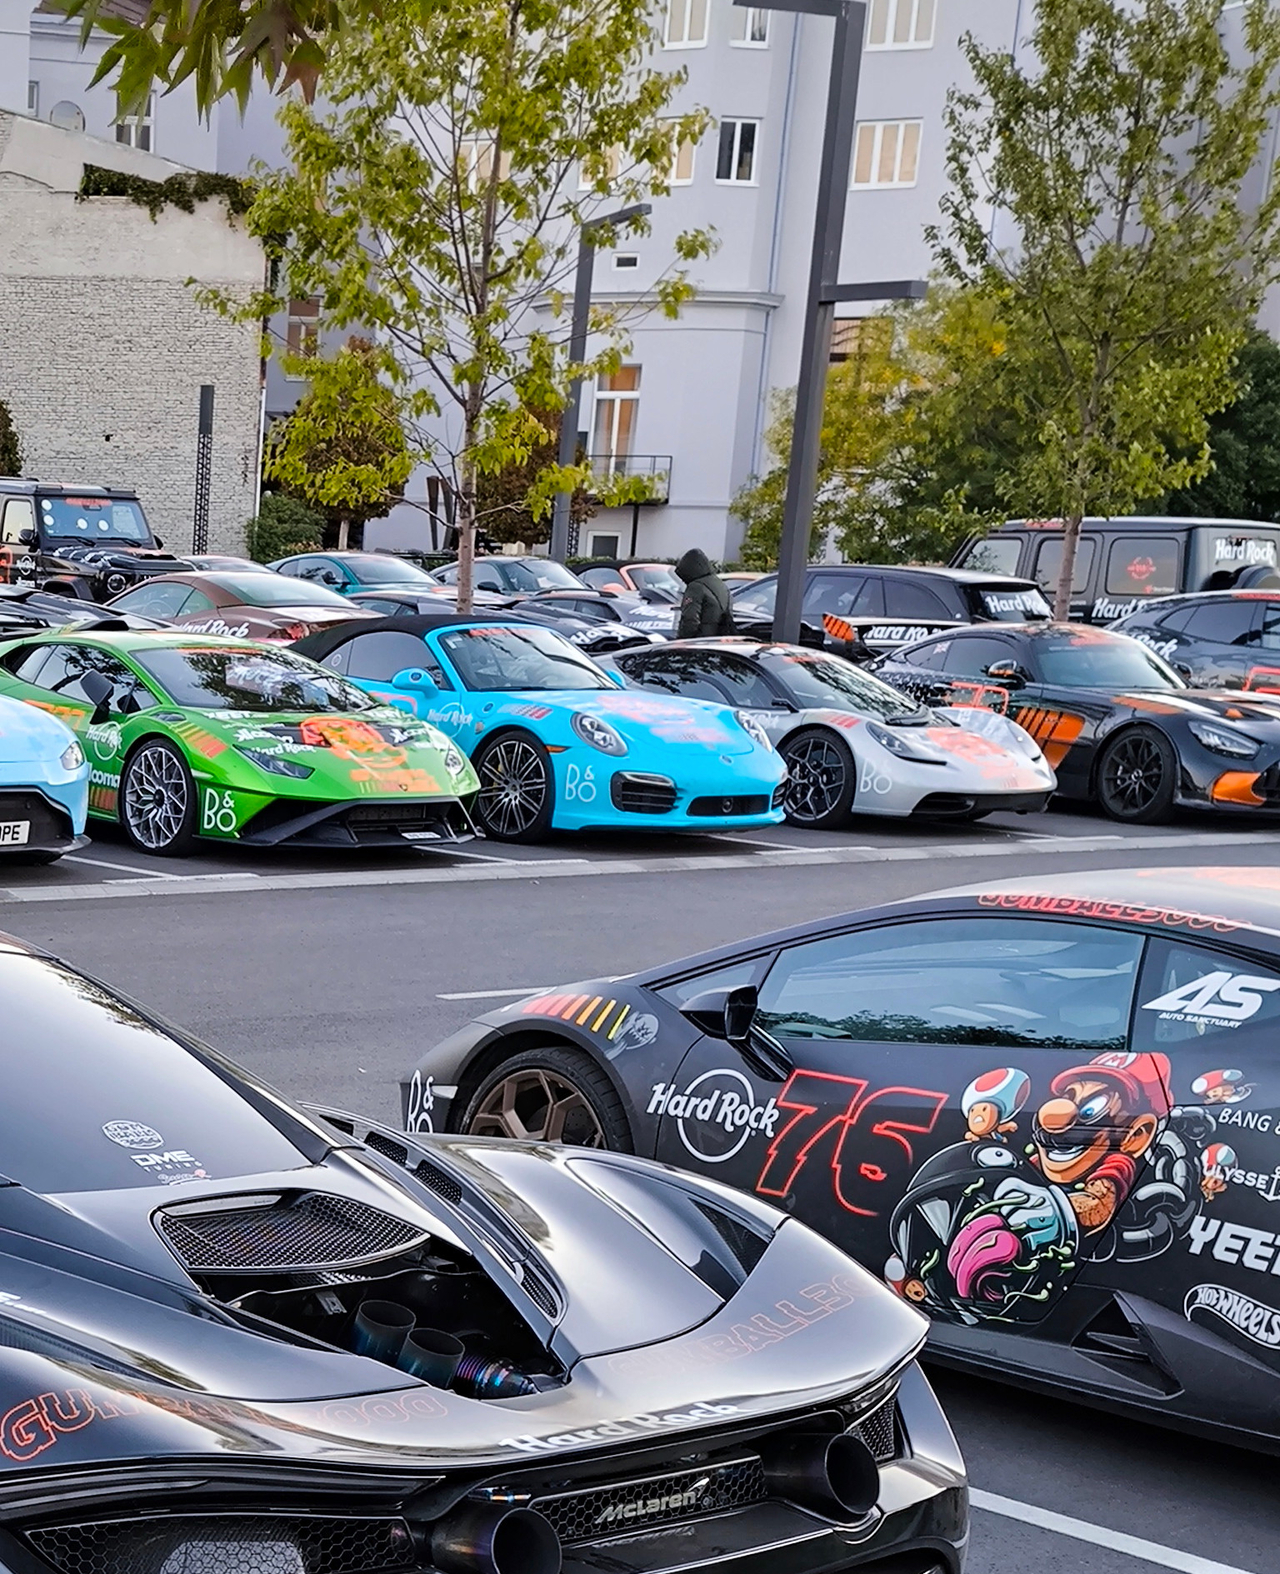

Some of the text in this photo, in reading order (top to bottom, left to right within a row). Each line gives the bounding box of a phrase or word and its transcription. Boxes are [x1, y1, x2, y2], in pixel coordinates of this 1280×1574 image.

[1215, 539, 1275, 564] Hard Rock
[985, 594, 1024, 613] Hard
[203, 787, 237, 832] B&O
[1158, 1012, 1242, 1028] AUTO SANCTUARY
[646, 1083, 780, 1139] Hard Rock
[1218, 1107, 1272, 1132] BANG
[756, 1068, 950, 1217] 76
[1203, 1162, 1269, 1190] ULYSSE
[498, 1400, 754, 1452] Hard Rock
[594, 1491, 697, 1525] McLaren
